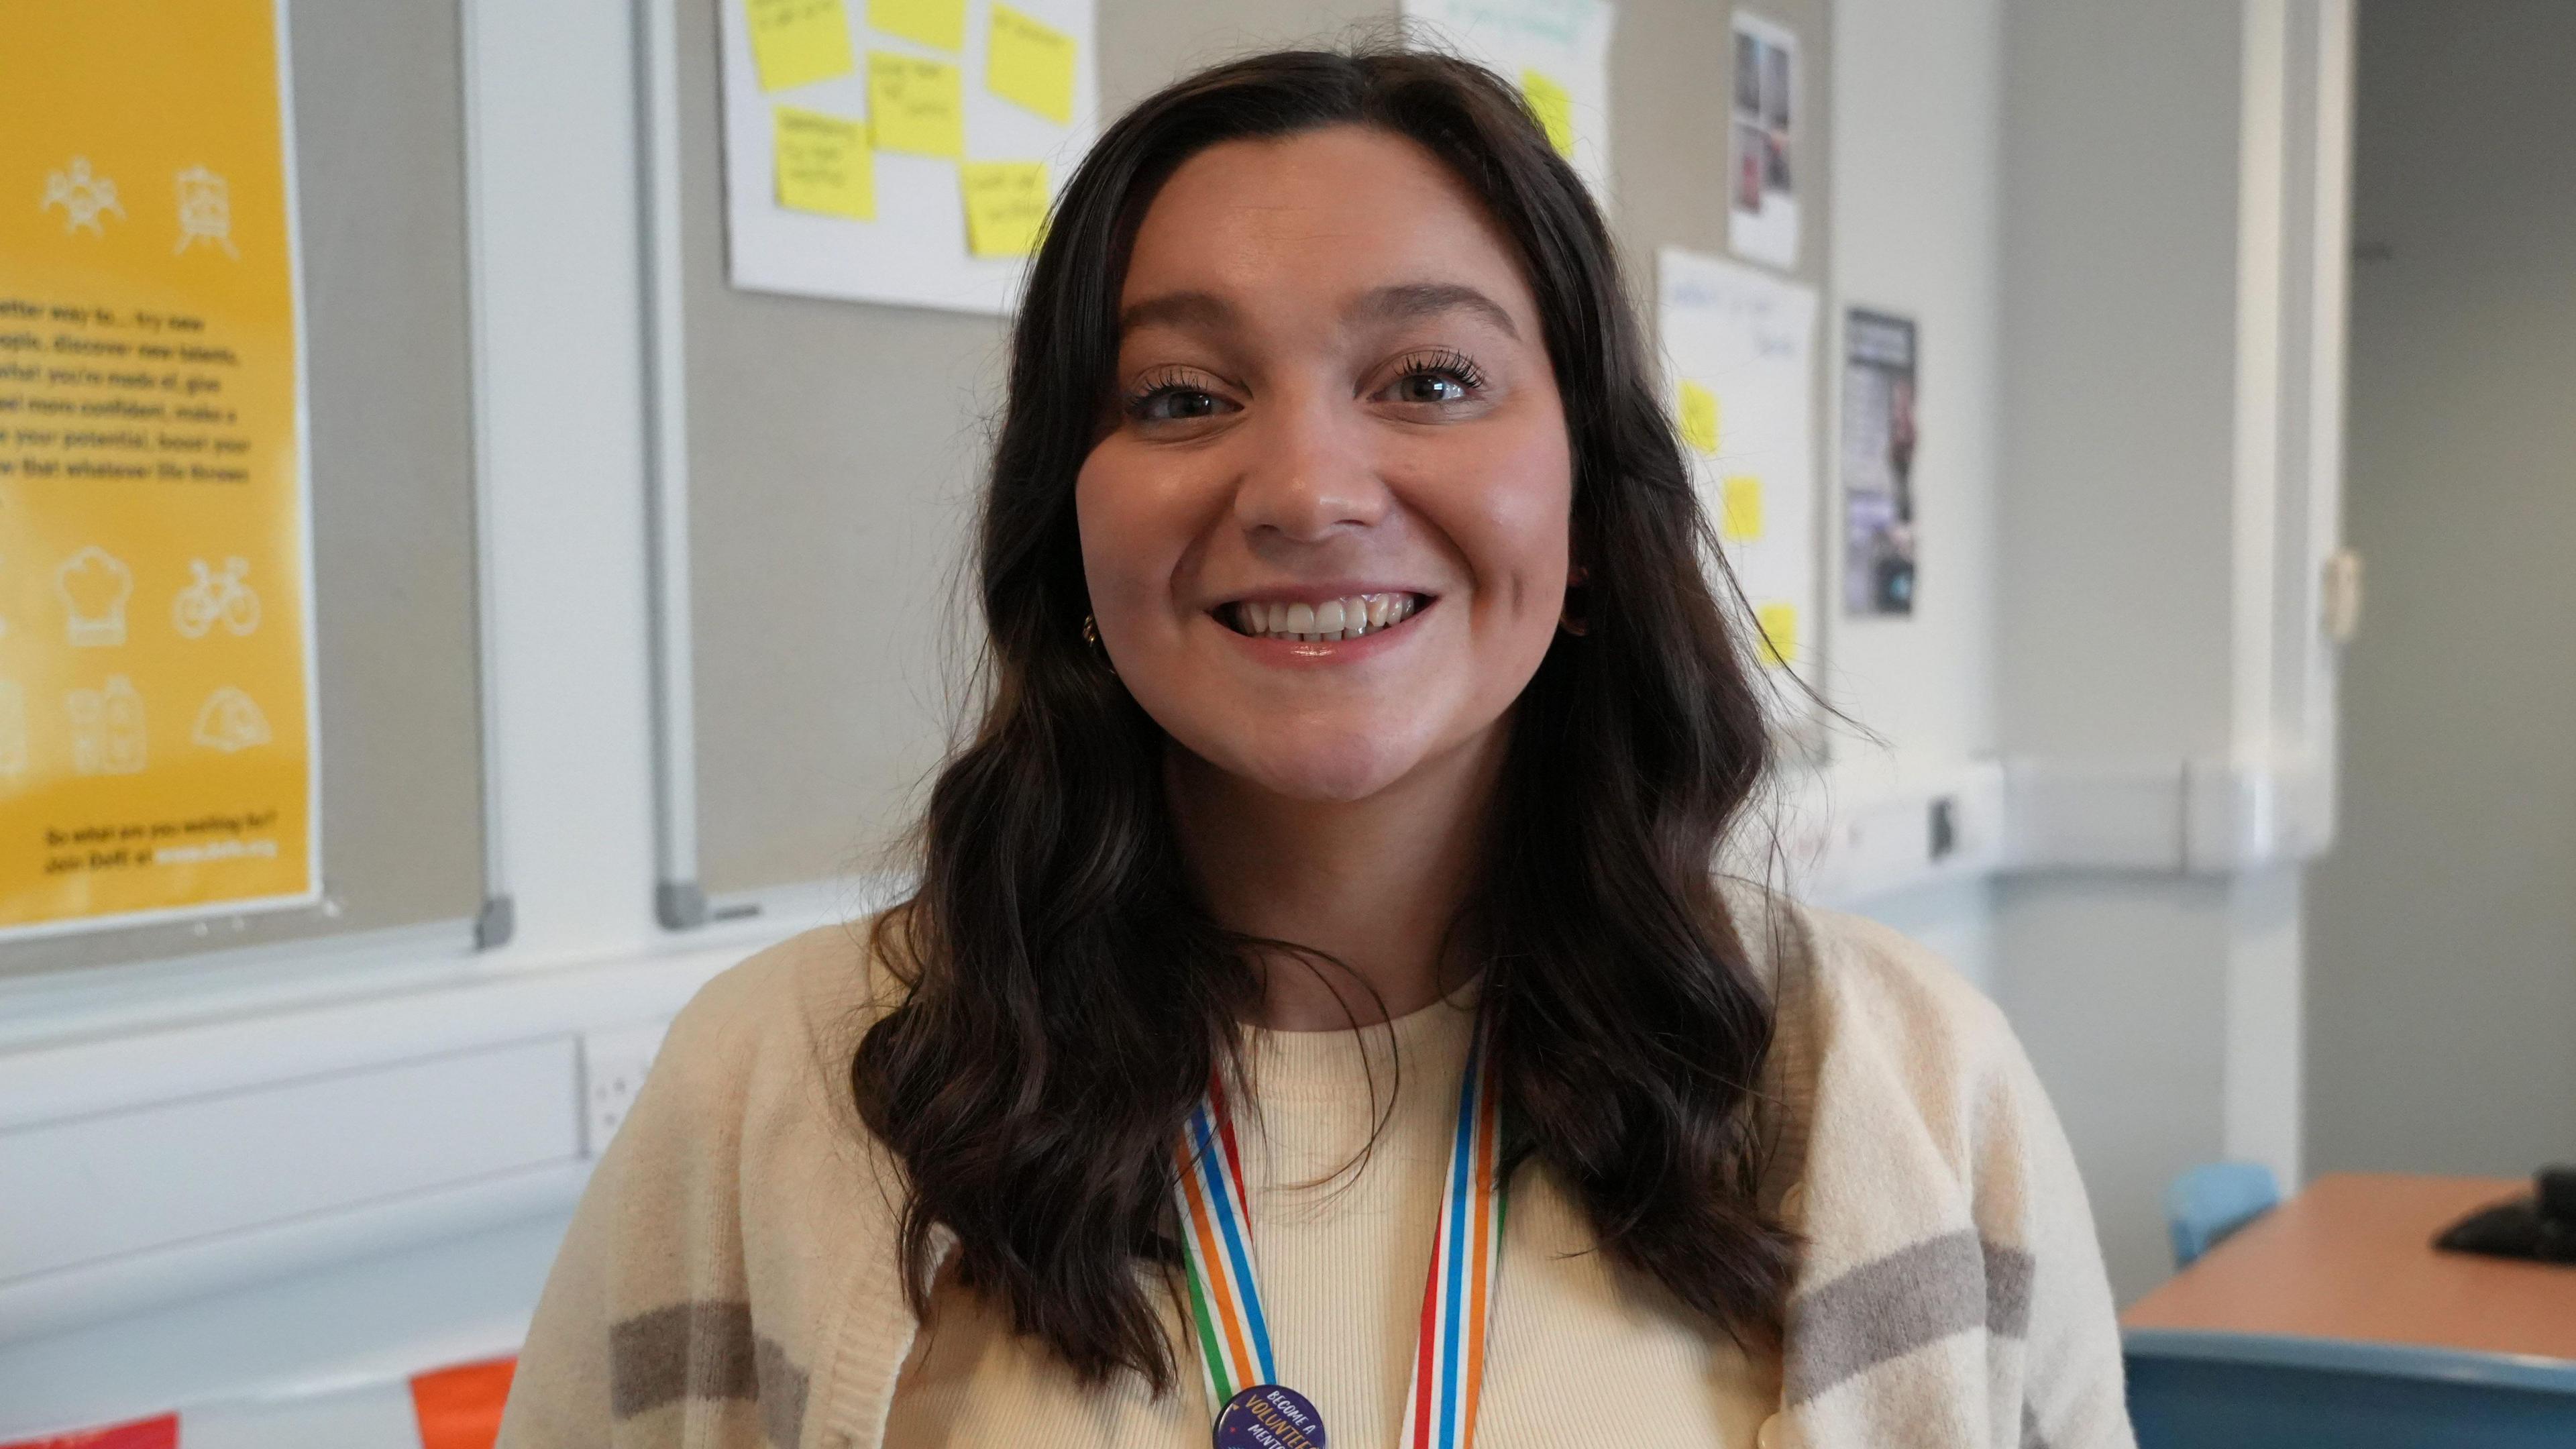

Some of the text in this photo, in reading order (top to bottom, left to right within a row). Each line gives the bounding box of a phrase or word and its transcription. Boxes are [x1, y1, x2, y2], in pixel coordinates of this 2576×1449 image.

[1246, 1393, 1322, 1449] VOLUNTEE
[1267, 1390, 1316, 1435] BECOME A
